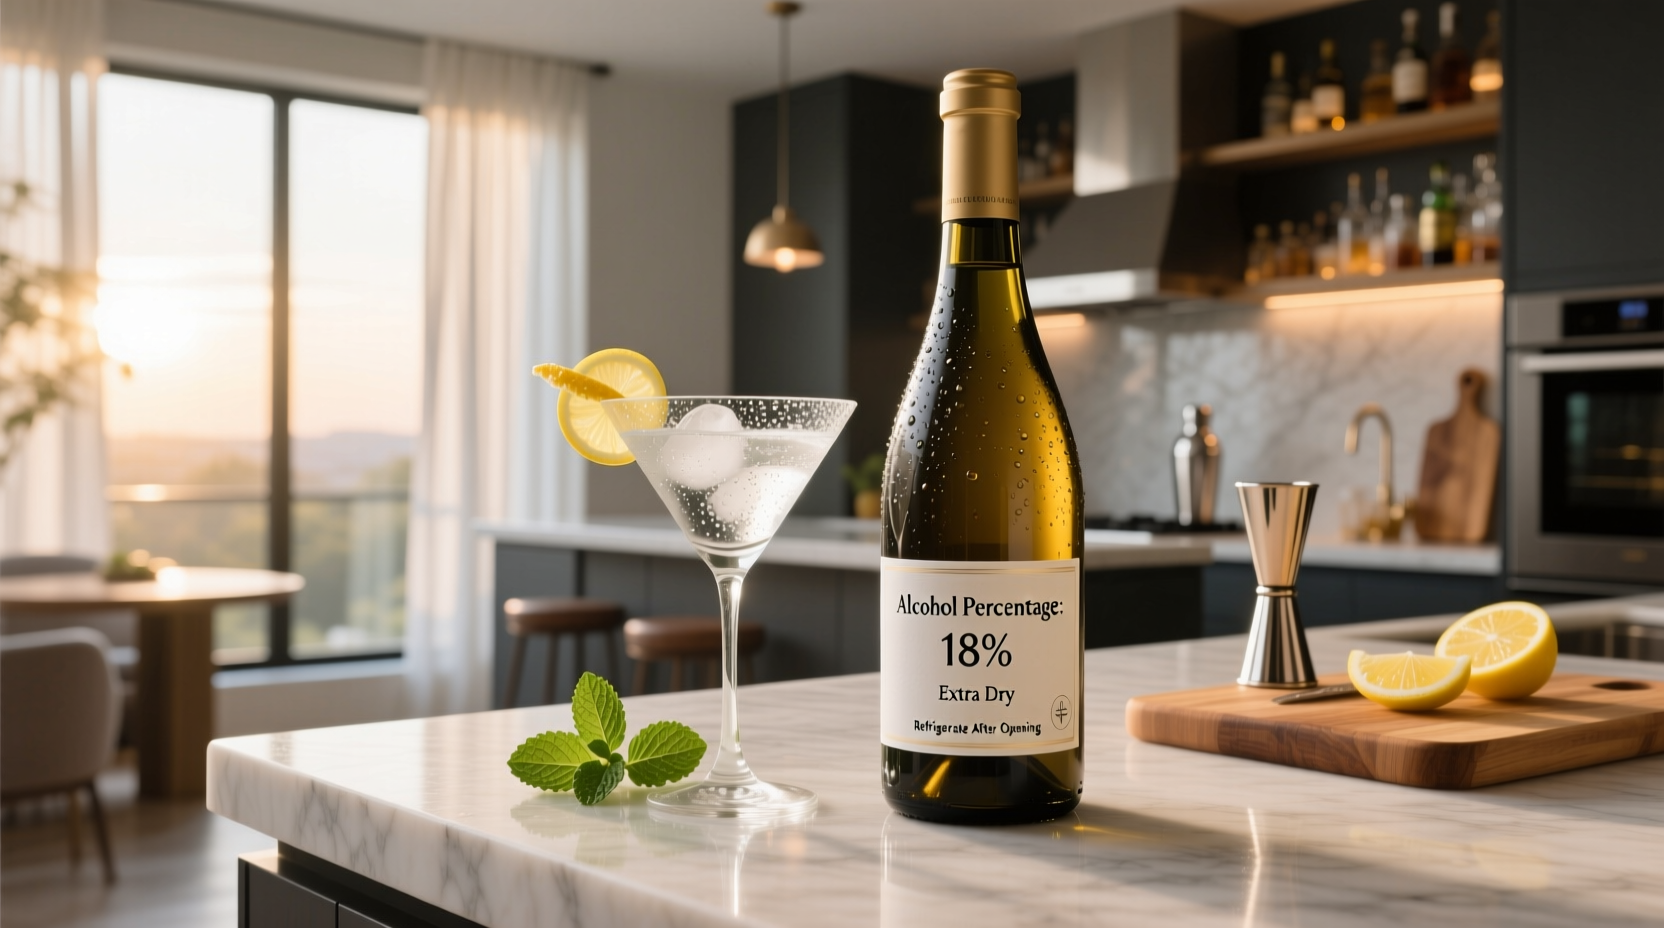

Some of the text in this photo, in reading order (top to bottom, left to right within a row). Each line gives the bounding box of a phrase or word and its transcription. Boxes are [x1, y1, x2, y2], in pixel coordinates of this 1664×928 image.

[896, 594, 1064, 621] Alcohol Percentage:
[941, 632, 1012, 667] 18%
[938, 685, 1015, 707] Extra Dry
[914, 719, 968, 736] Refrigerate
[972, 722, 997, 735] After
